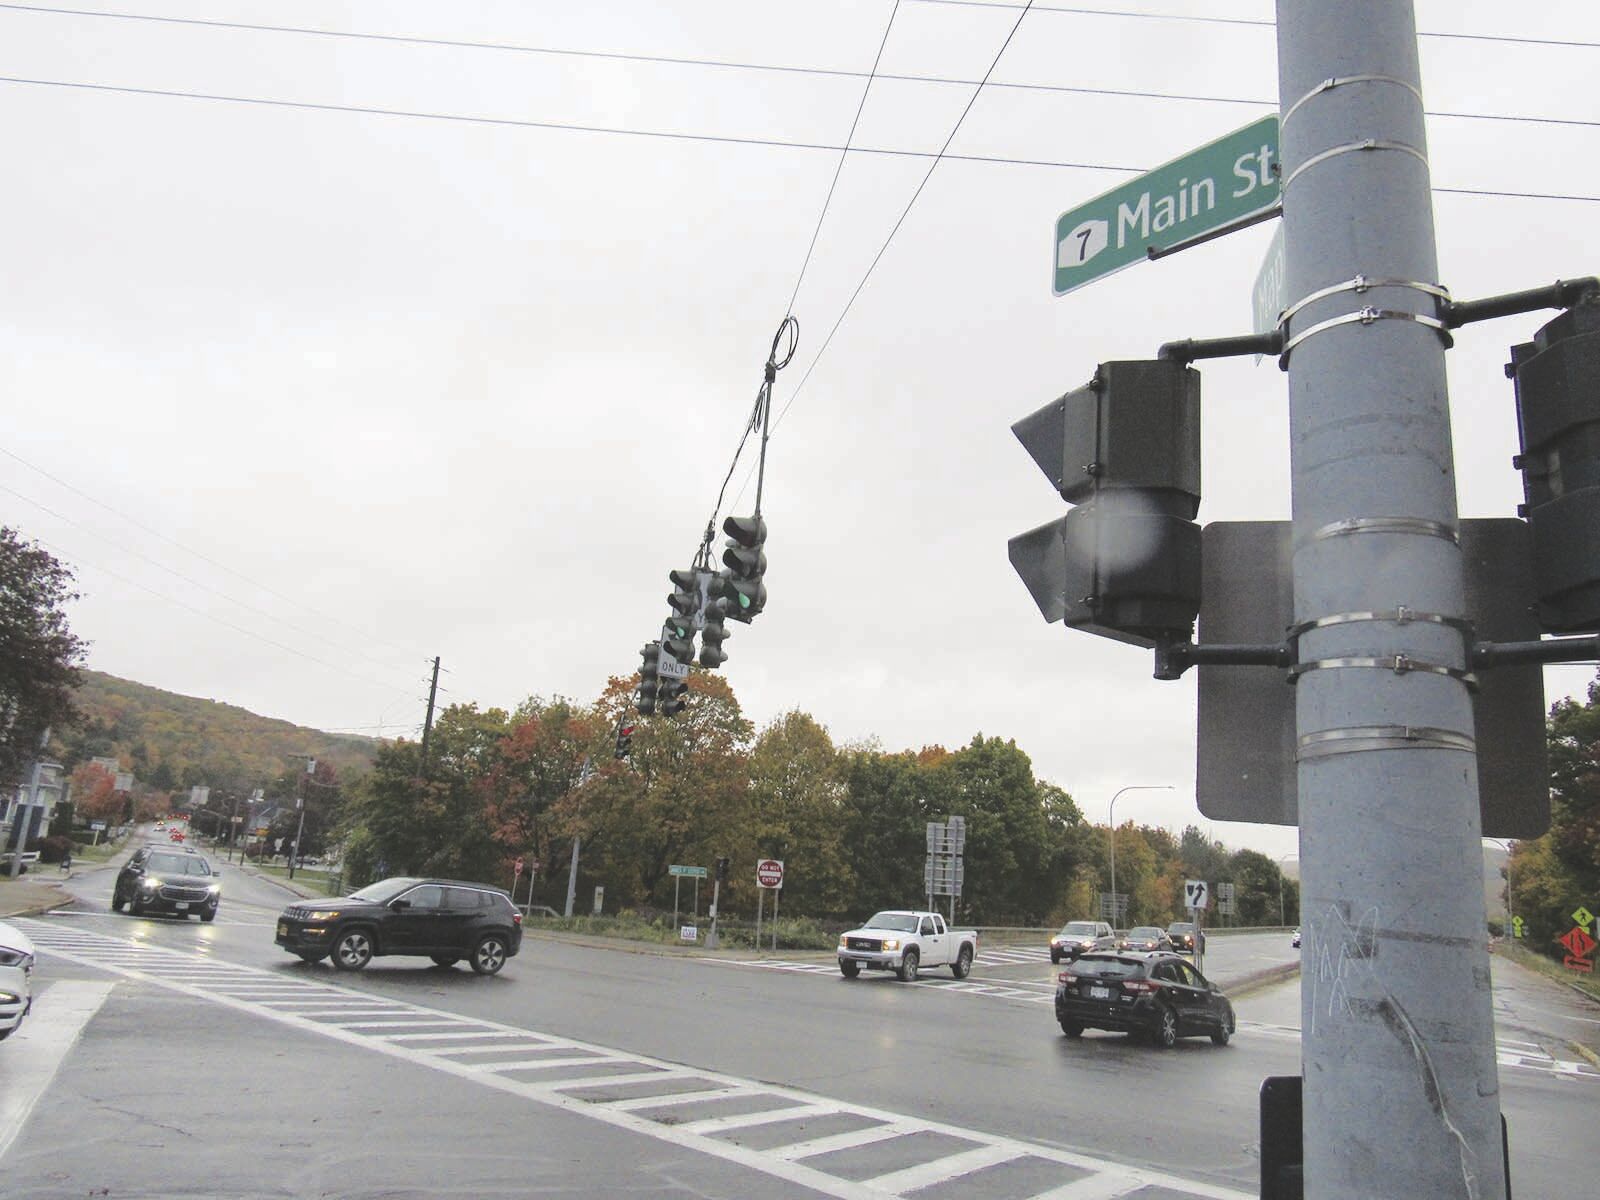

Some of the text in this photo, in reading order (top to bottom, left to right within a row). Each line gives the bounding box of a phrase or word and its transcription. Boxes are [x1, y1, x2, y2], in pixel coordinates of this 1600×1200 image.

[1076, 144, 1273, 261] 7 Main St
[662, 662, 685, 675] ONLY
